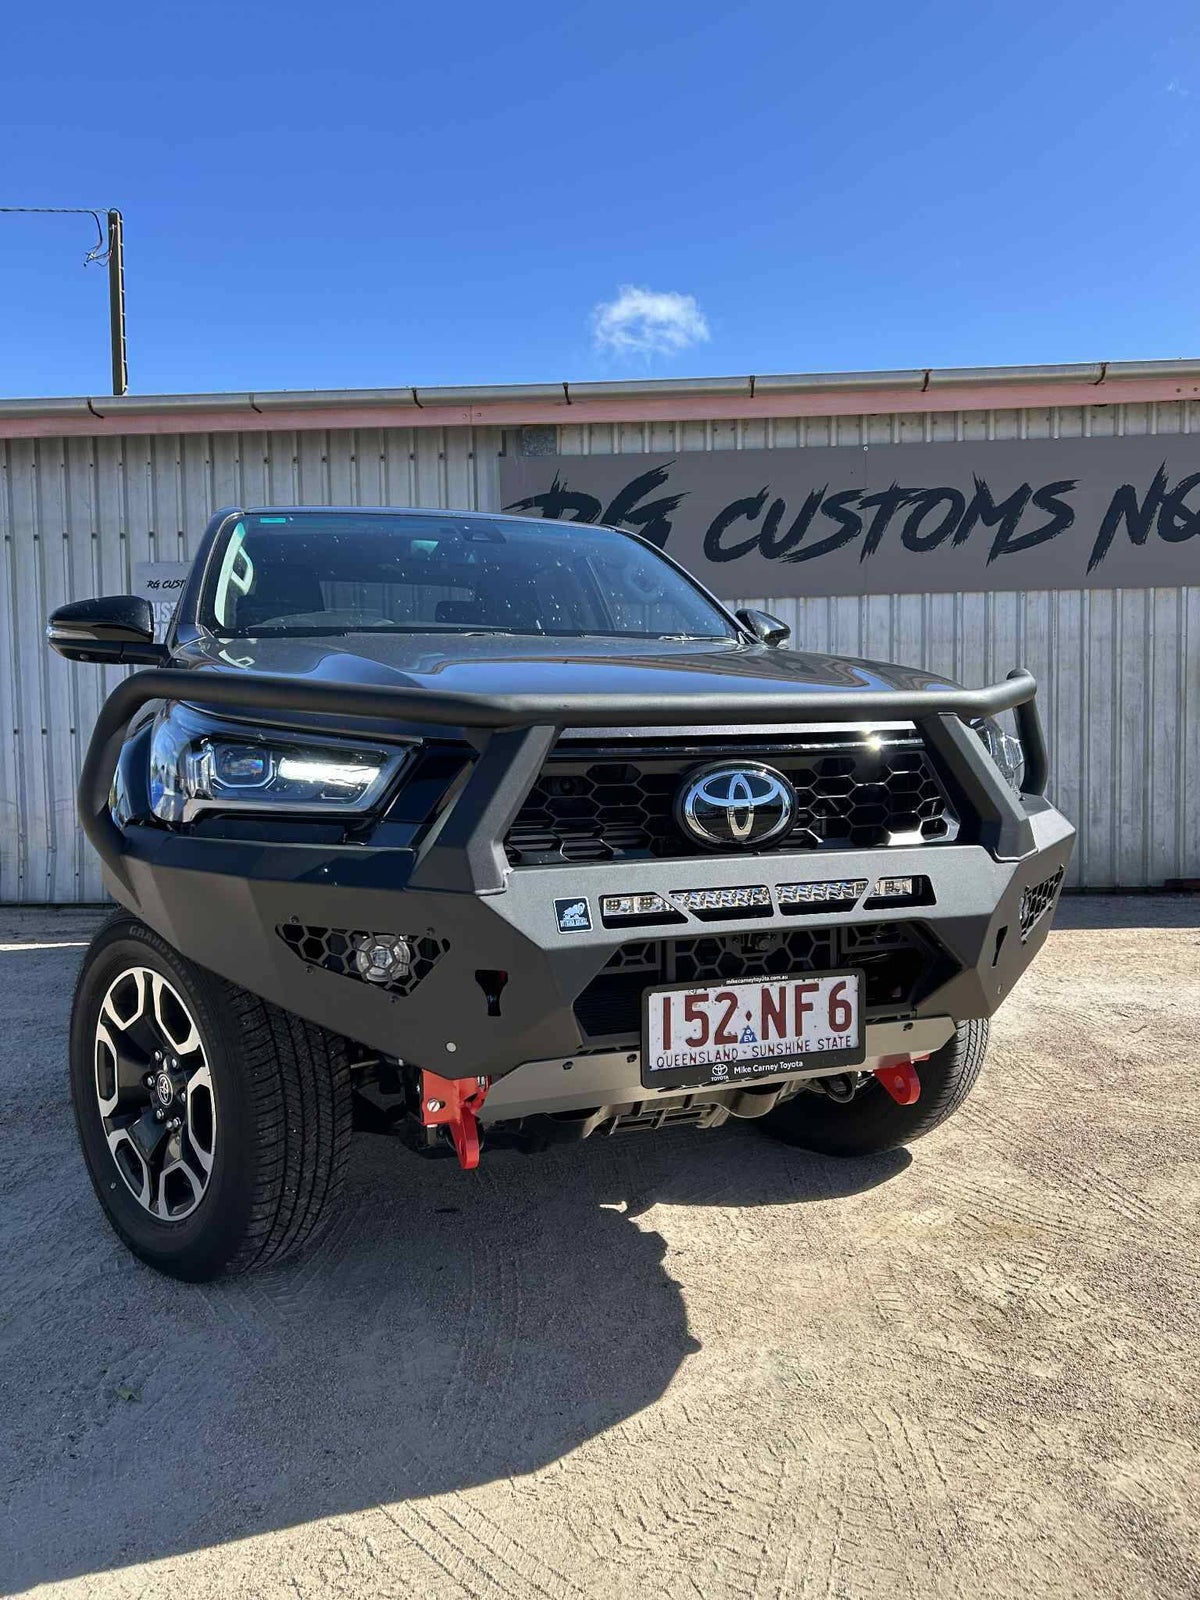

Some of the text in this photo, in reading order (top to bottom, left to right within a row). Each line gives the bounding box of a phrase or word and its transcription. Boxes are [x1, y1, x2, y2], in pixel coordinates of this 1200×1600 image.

[704, 472, 1082, 567] CUSTOMS
[147, 580, 160, 589] RG
[656, 1036, 851, 1068] QUEENSLAND SUNSHINE STATE
[733, 1061, 803, 1074] Mike Carney Toyota
